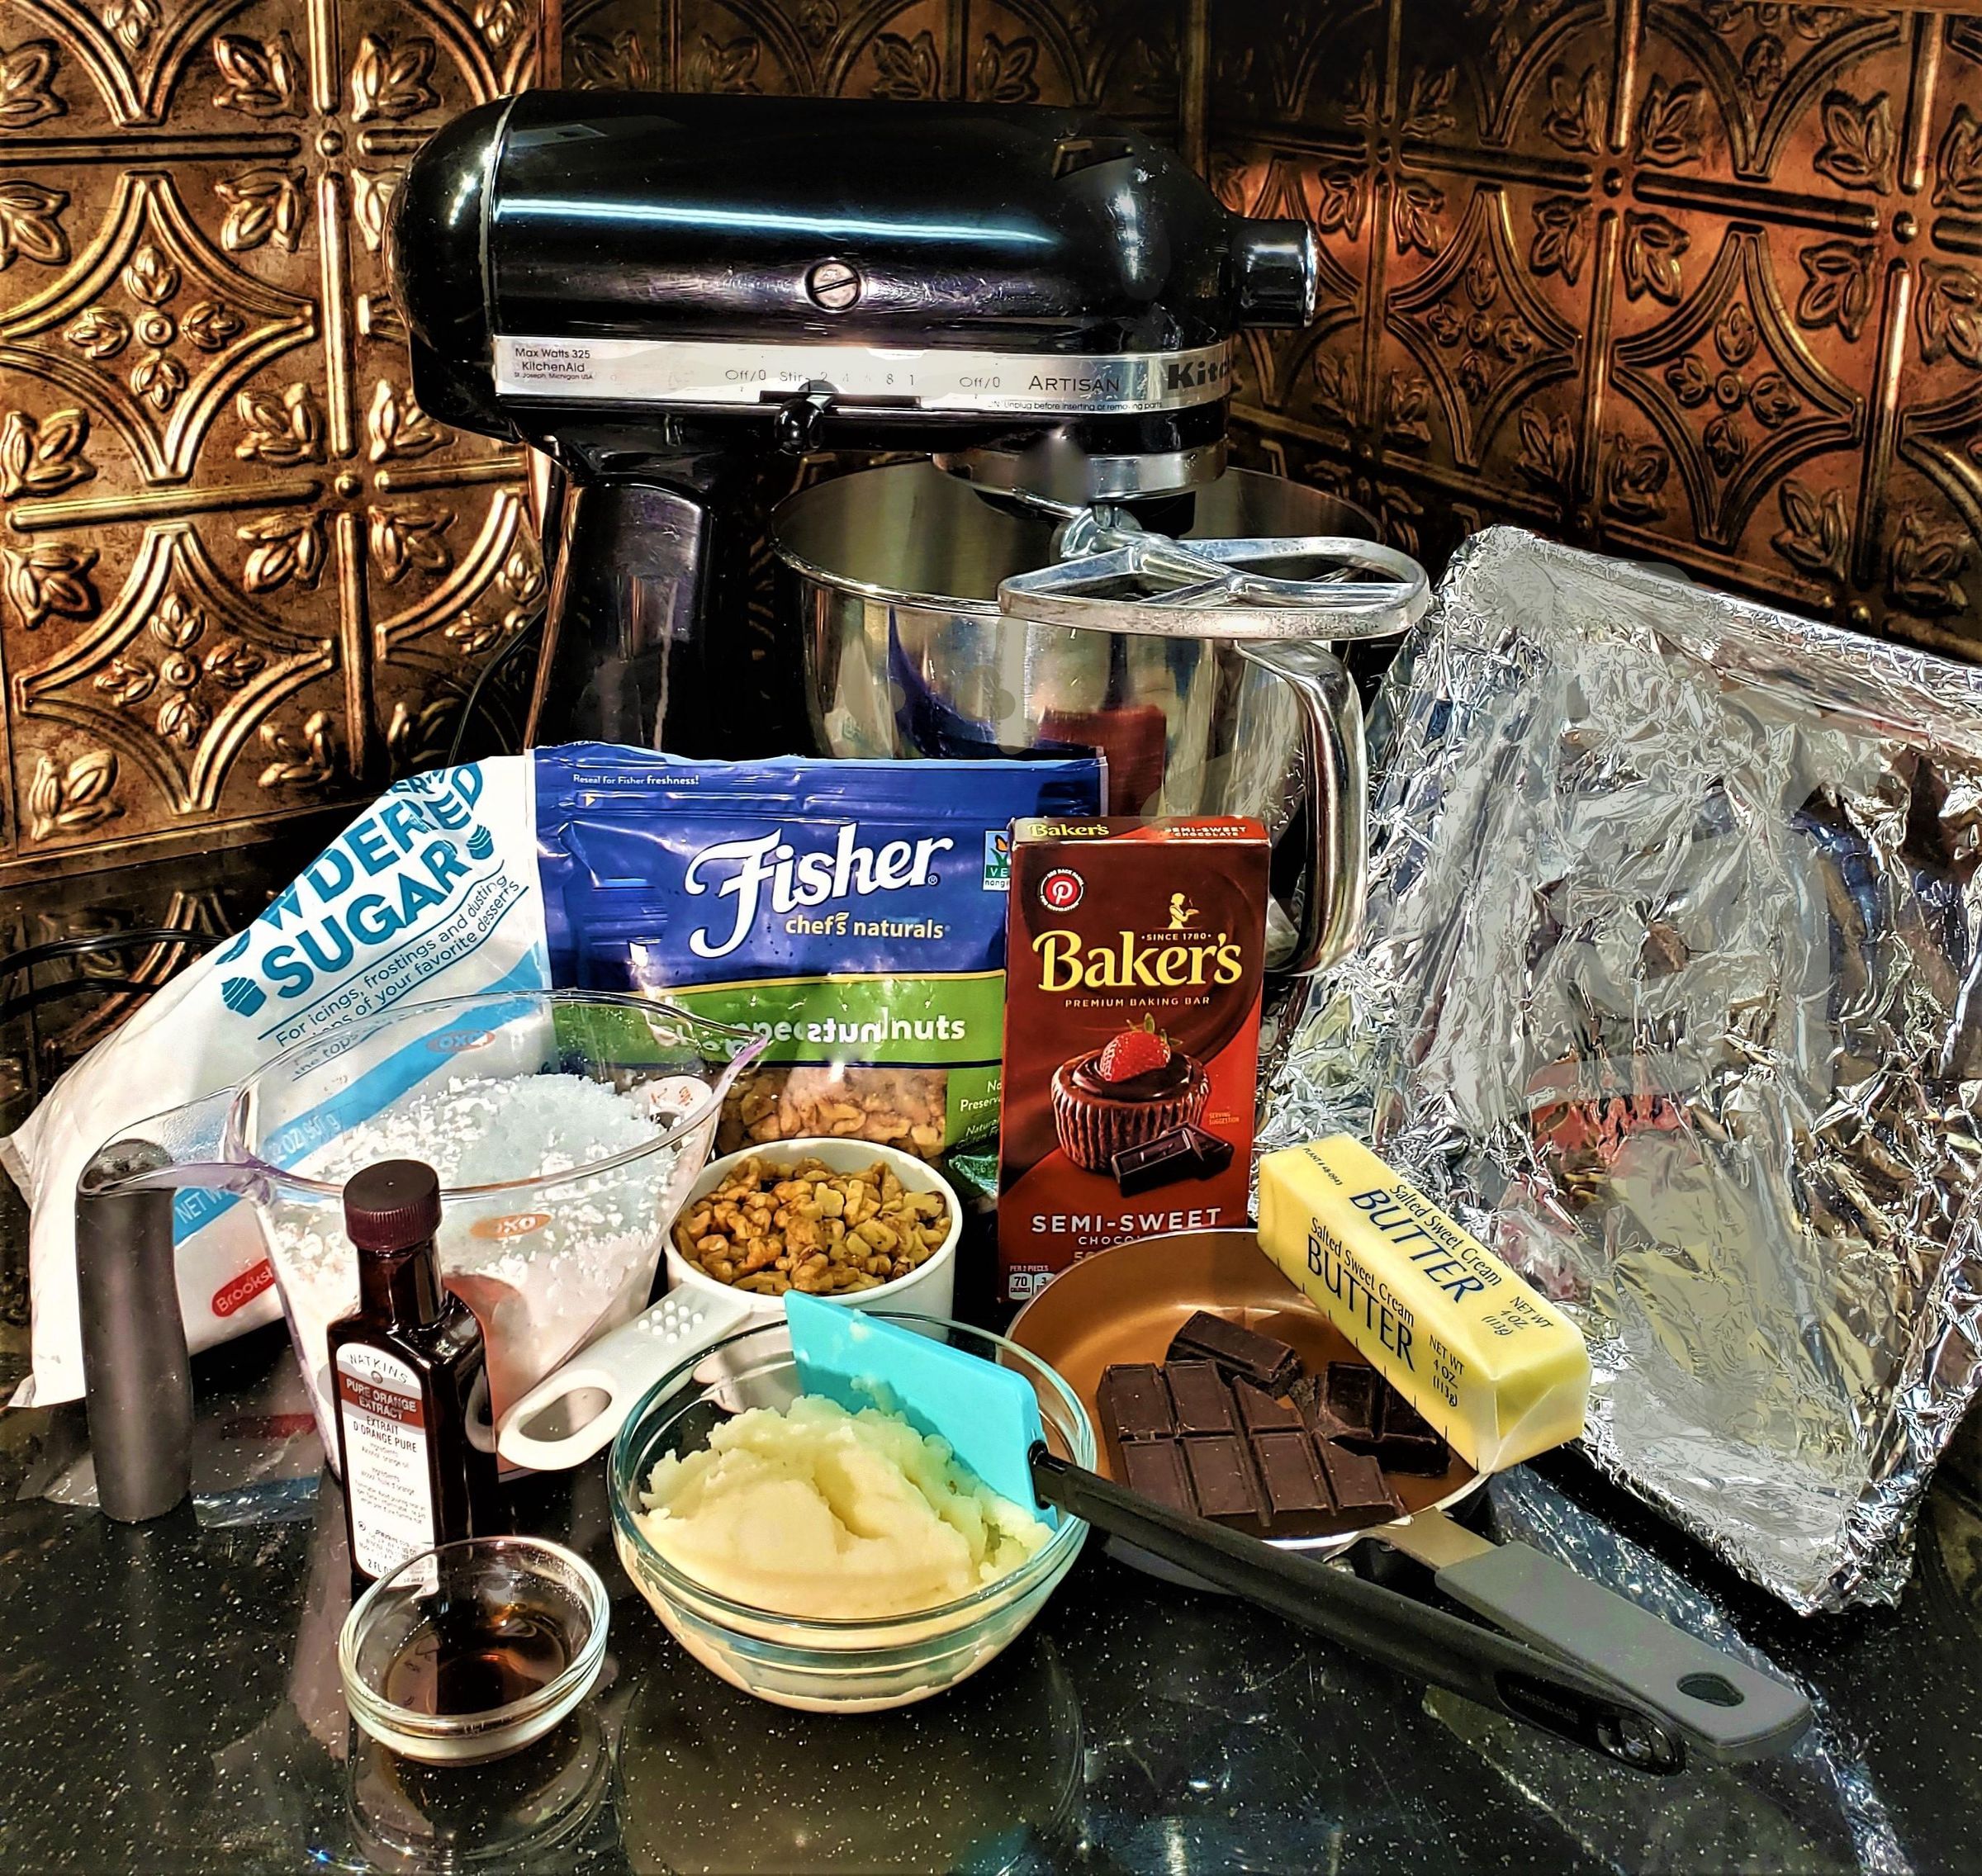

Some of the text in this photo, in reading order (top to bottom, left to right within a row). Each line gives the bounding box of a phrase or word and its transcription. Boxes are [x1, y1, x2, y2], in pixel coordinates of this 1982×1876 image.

[515, 348, 590, 358] Max Watts 325
[522, 361, 586, 372] KitchenAid
[1033, 401, 1060, 410] before
[1061, 402, 1095, 411] inserting
[1107, 403, 1143, 411] remong
[572, 774, 699, 785] Reseal for Fisher freshness!
[685, 823, 953, 959] Fisher
[262, 840, 473, 999] SUGAR
[853, 919, 944, 939] naturals
[355, 996, 374, 1016] of
[377, 974, 413, 1006] your
[414, 930, 479, 977] favorite
[477, 880, 520, 933] desserts
[1145, 933, 1179, 941] SINCE
[276, 1022, 306, 1047] For
[308, 987, 364, 1027] icings,
[363, 942, 437, 988] frostings
[438, 913, 467, 943] and
[467, 875, 508, 918] dusting
[1065, 996, 1211, 1007] PREMIUM BAKING BAR
[174, 1189, 208, 1225] NET
[1031, 1208, 1222, 1233] SEMI-SWEET
[1349, 1188, 1485, 1304] BUTTER
[1389, 1183, 1502, 1286] Salted Sweet Cream
[1014, 1276, 1027, 1287] 70
[1310, 1217, 1415, 1326] Salted Sweet Cream
[1306, 1234, 1415, 1373] BUTTER
[1511, 1296, 1554, 1329] NET WT
[1481, 1315, 1514, 1337] (113g)
[1429, 1334, 1465, 1376] NET WT
[1432, 1358, 1440, 1371] 4
[346, 1378, 417, 1413] PURE ORANGE
[1432, 1376, 1458, 1408] (113g)
[358, 1395, 405, 1420] EXTRACT
[366, 1415, 399, 1435] EXTRAIT
[394, 1437, 417, 1453] PURE
